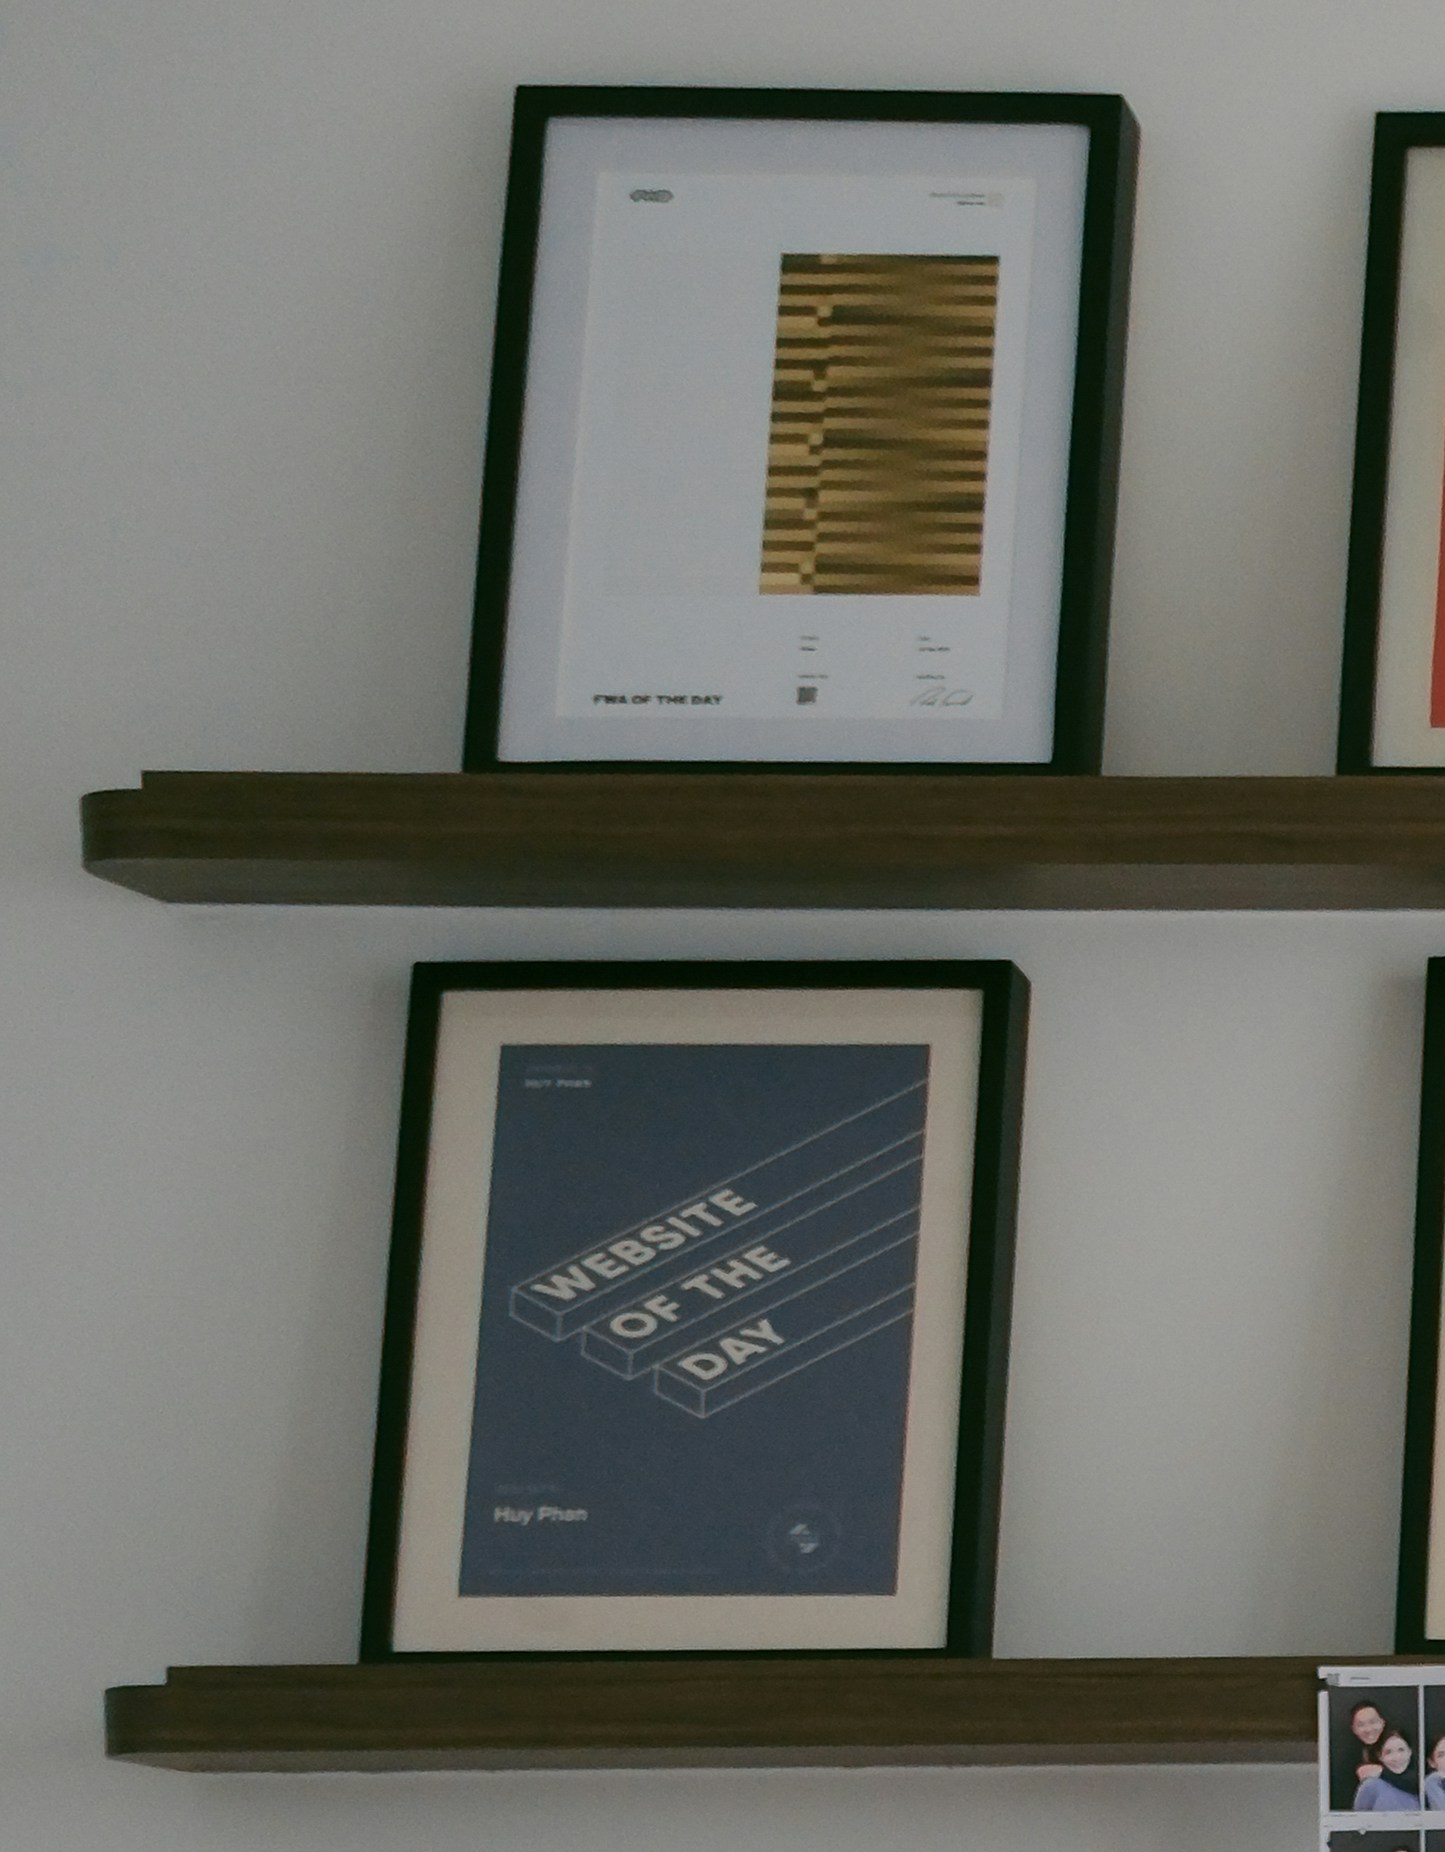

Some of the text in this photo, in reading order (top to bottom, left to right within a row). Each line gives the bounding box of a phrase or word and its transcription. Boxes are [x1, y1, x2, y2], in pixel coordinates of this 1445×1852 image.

[593, 694, 723, 705] FWA OF THE DAY
[530, 1188, 758, 1300] WEBSITE
[609, 1245, 791, 1339] OF THE
[677, 1318, 786, 1381] DAY
[494, 1506, 588, 1526] Huy Phan
